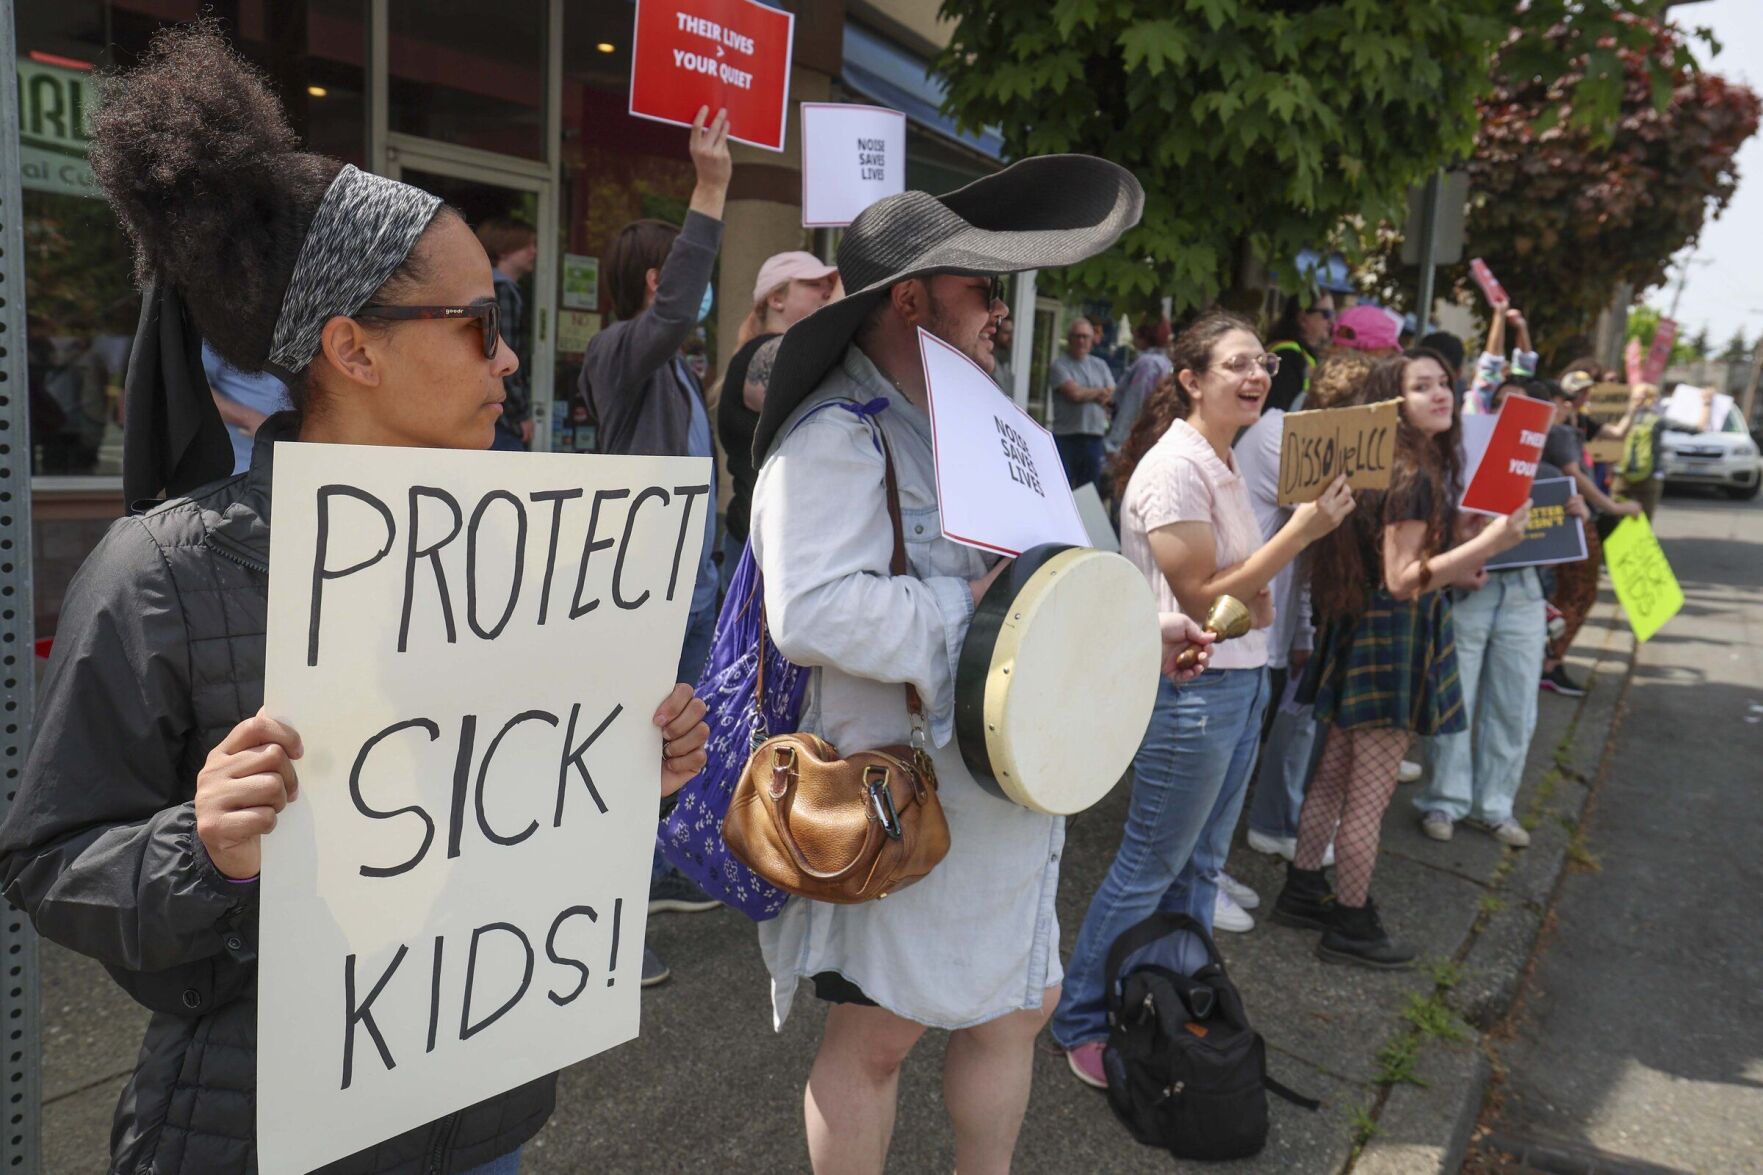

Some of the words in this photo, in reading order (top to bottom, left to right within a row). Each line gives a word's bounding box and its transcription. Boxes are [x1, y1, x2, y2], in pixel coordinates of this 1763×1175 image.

[676, 11, 722, 42] THEIR
[723, 27, 755, 56] LIVES
[673, 48, 718, 77] YOUR
[719, 62, 753, 90] QUIET
[857, 137, 886, 152] NOISE
[859, 152, 886, 167] SAVES
[861, 167, 885, 181] LIVES
[993, 414, 1031, 458] NOISE
[1001, 438, 1039, 478] SAVES
[1008, 461, 1046, 498] LIVES
[307, 484, 710, 667] PROTECT
[348, 703, 624, 878] SICK
[340, 897, 623, 1091] KIDS!
